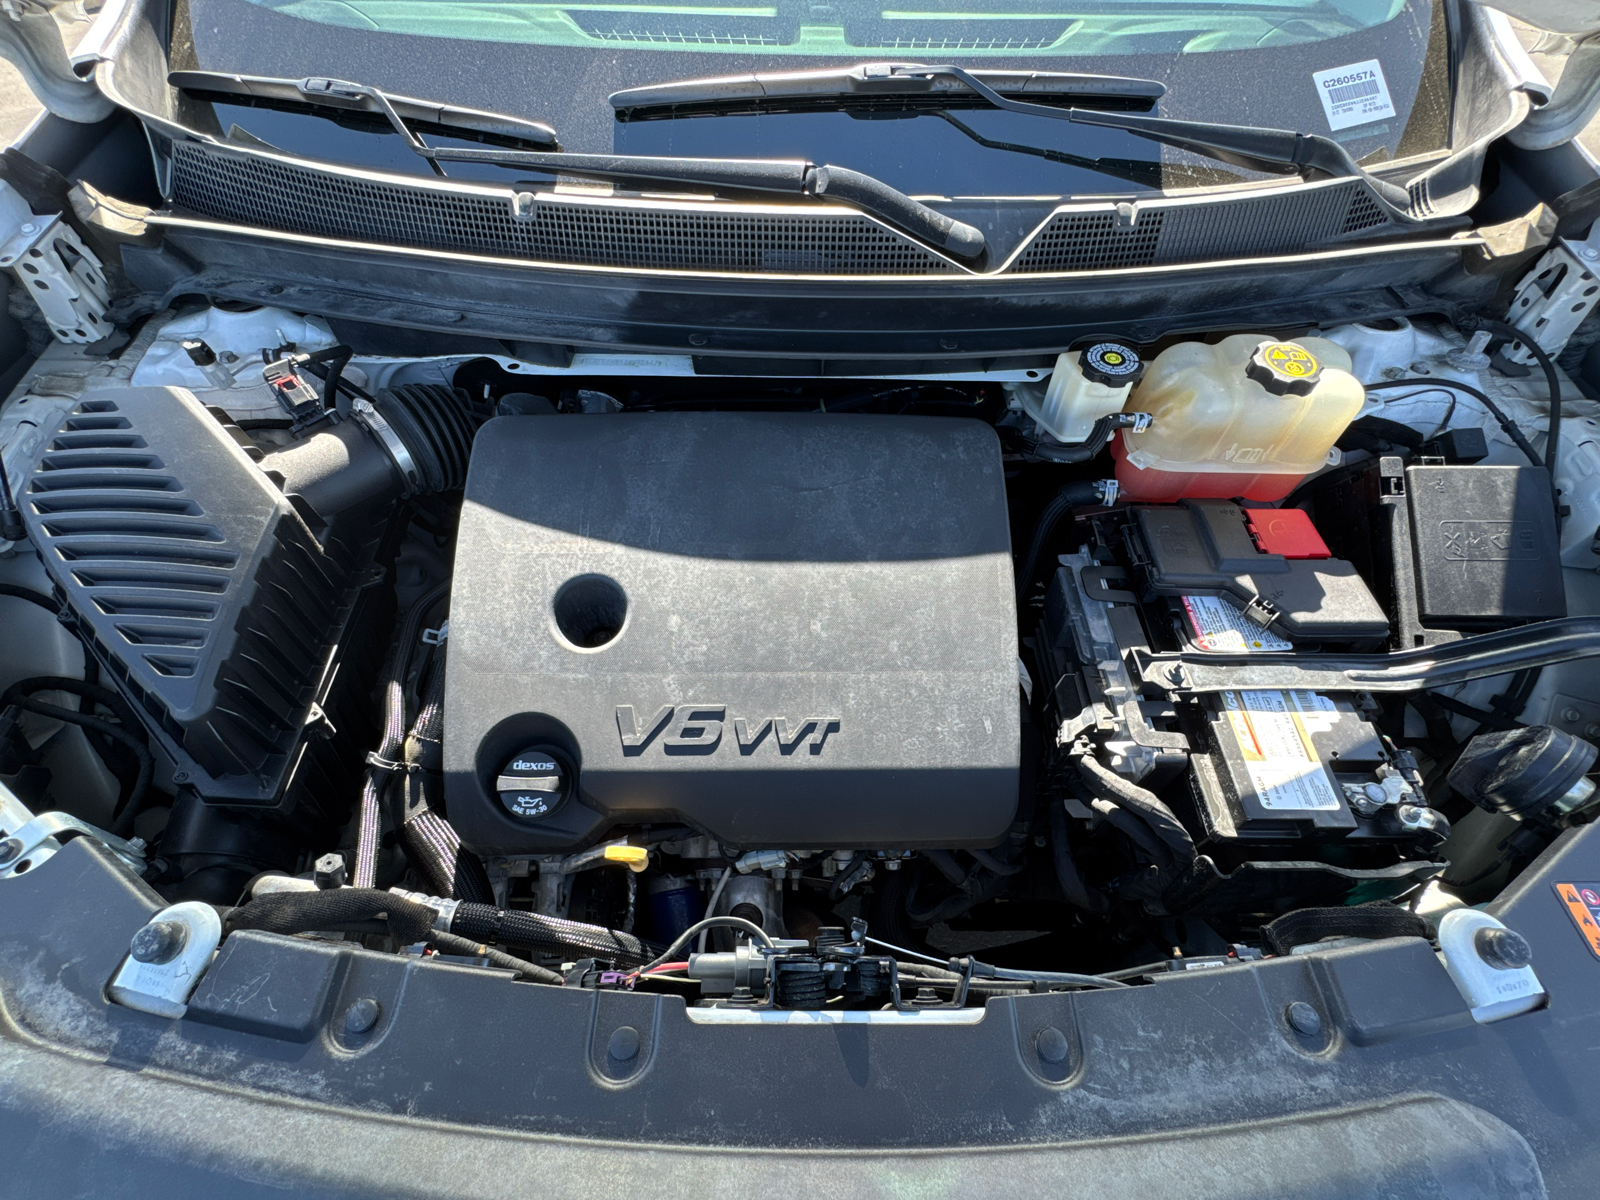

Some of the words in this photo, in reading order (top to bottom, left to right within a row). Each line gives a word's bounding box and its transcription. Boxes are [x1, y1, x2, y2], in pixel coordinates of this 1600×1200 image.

[616, 705, 726, 757] V6
[734, 717, 841, 756] VVT
[513, 760, 556, 770] dexos
[512, 804, 525, 815] SAE
[526, 804, 548, 816] 5W-30
